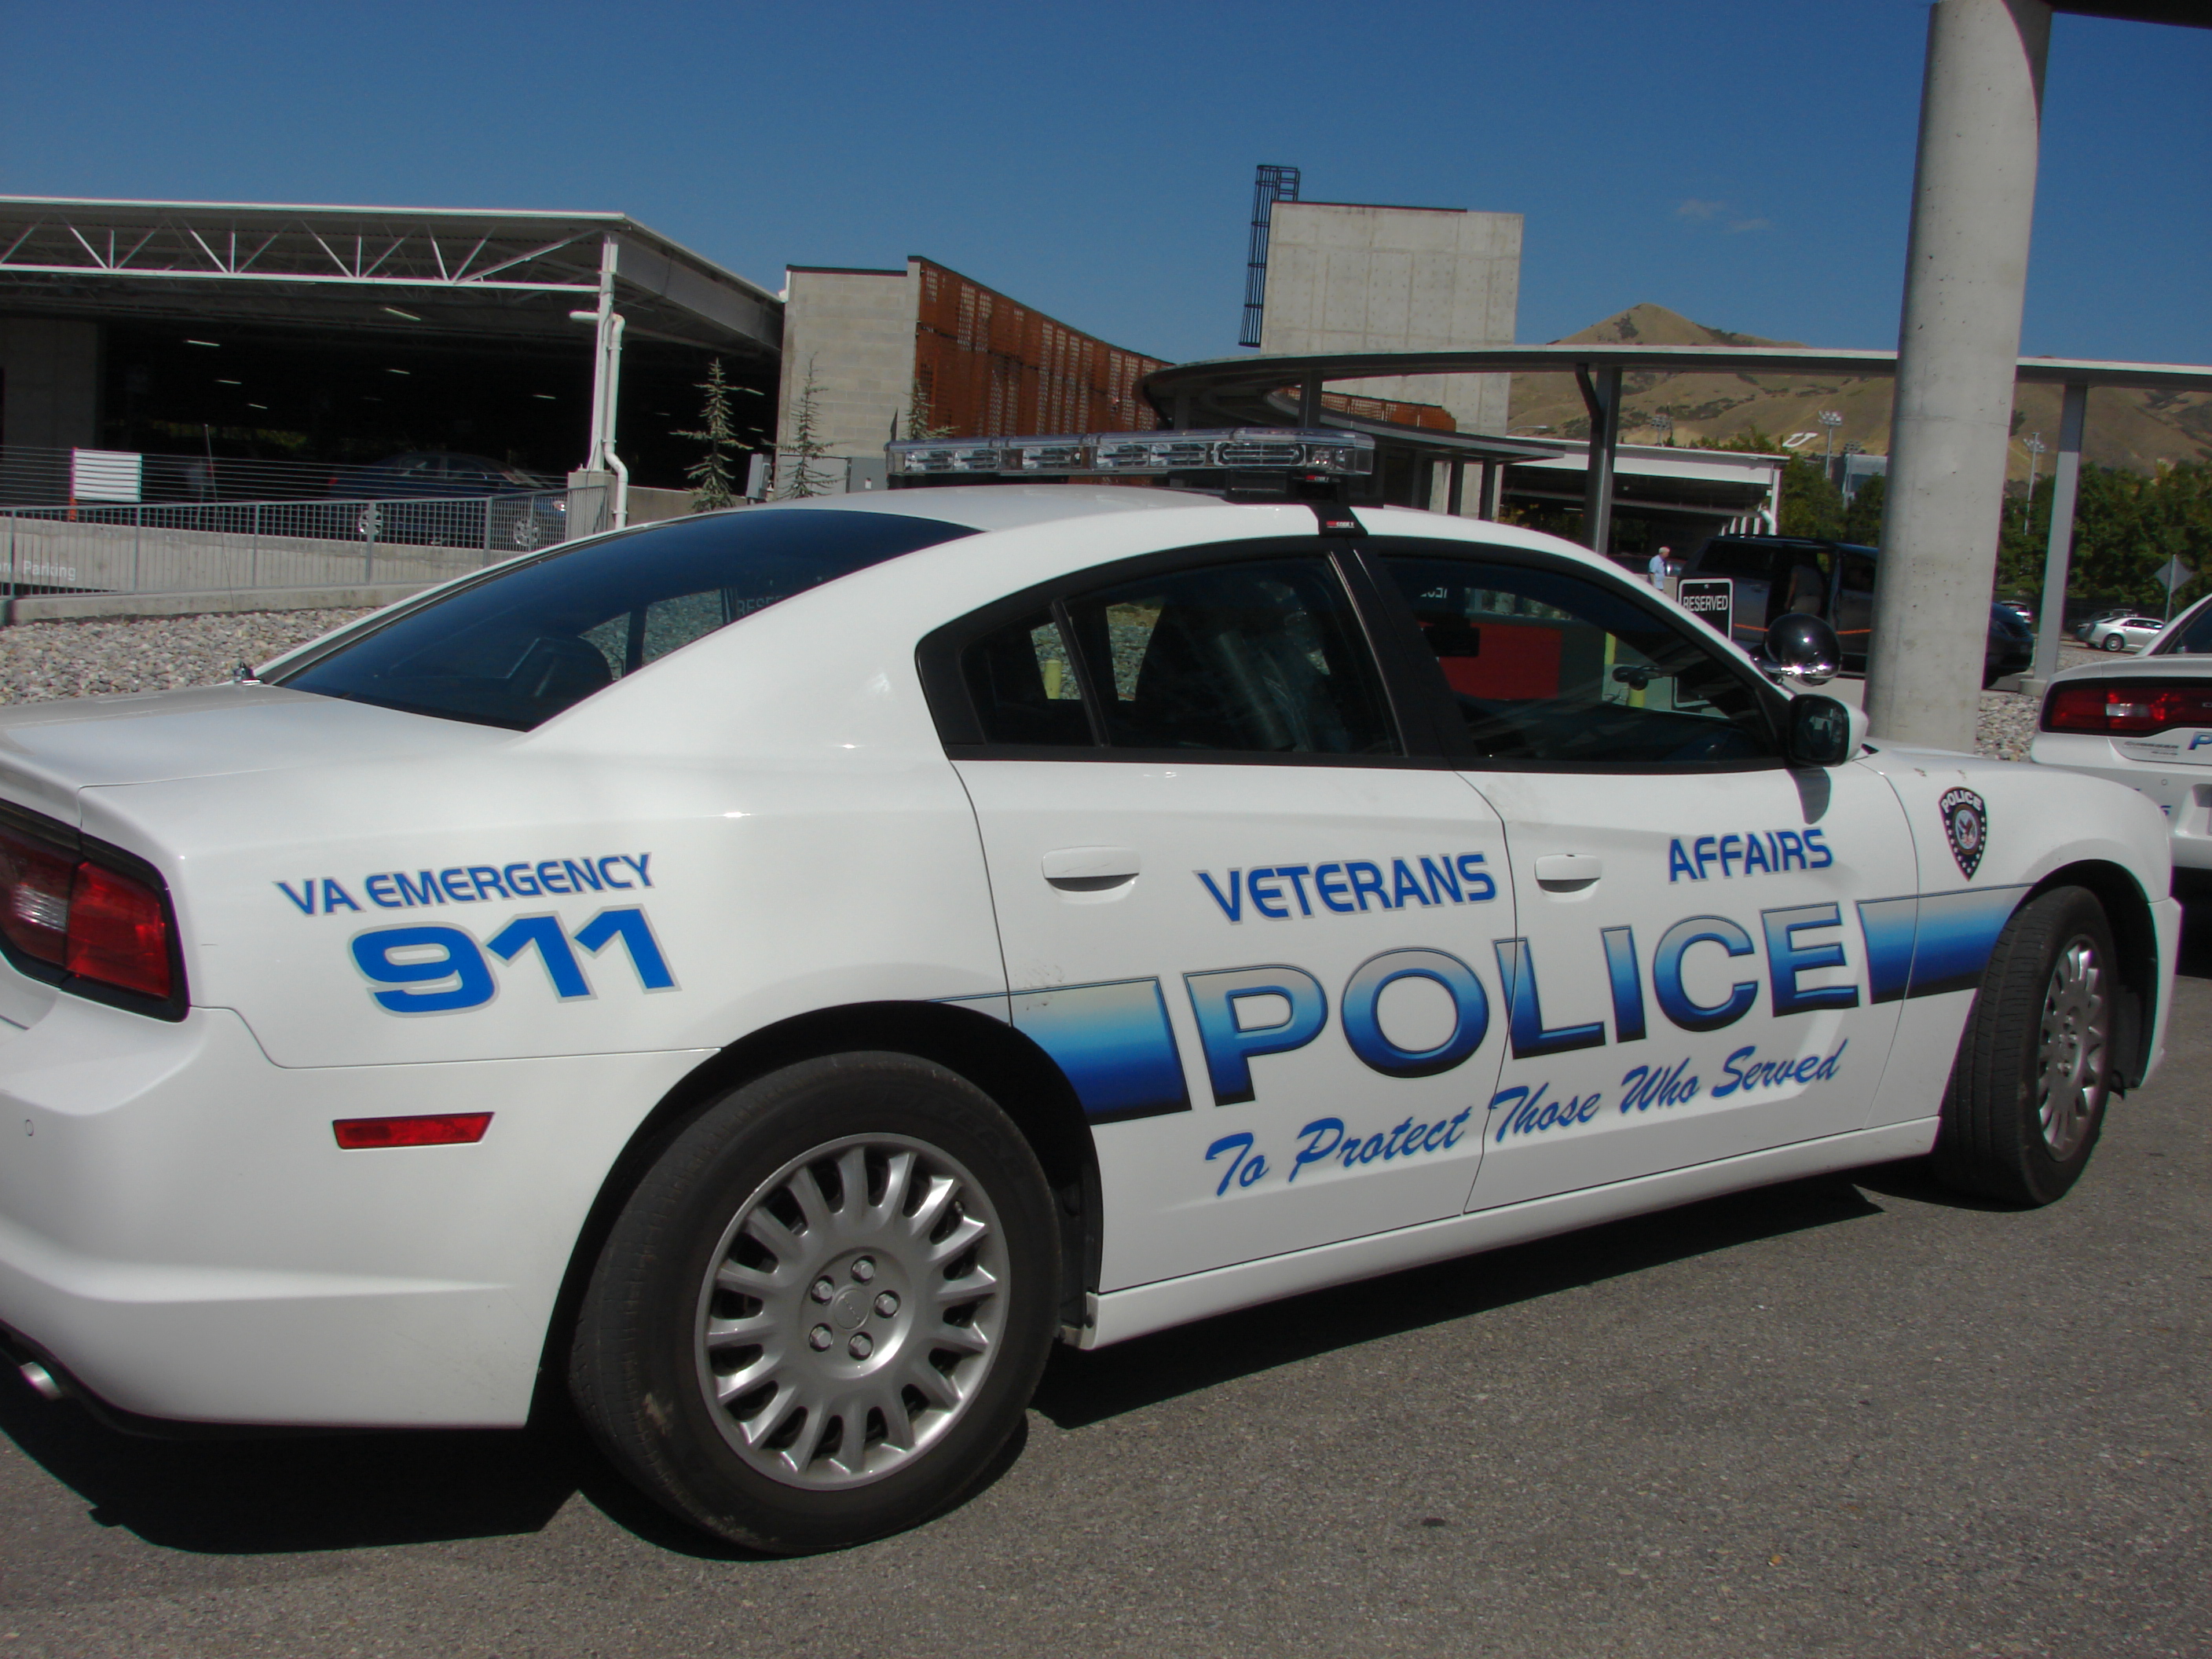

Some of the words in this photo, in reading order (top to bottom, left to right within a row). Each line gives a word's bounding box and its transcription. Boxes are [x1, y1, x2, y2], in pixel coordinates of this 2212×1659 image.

[23, 560, 76, 581] Parking
[1683, 595, 1728, 612] RESERVED
[1941, 789, 1982, 813] POLICE
[275, 878, 364, 915] VA
[364, 853, 653, 908] EMERGENCY
[1196, 852, 1499, 924] VETERANS
[1668, 828, 1835, 883] AFFAIRS
[349, 906, 679, 1016] 911
[1182, 902, 1859, 1108] POLICE
[1203, 1131, 1269, 1198] To
[1288, 1107, 1471, 1183] Protect
[1488, 1083, 1602, 1144] Those
[1619, 1057, 1701, 1114] Who
[1710, 1038, 1849, 1099] Served
